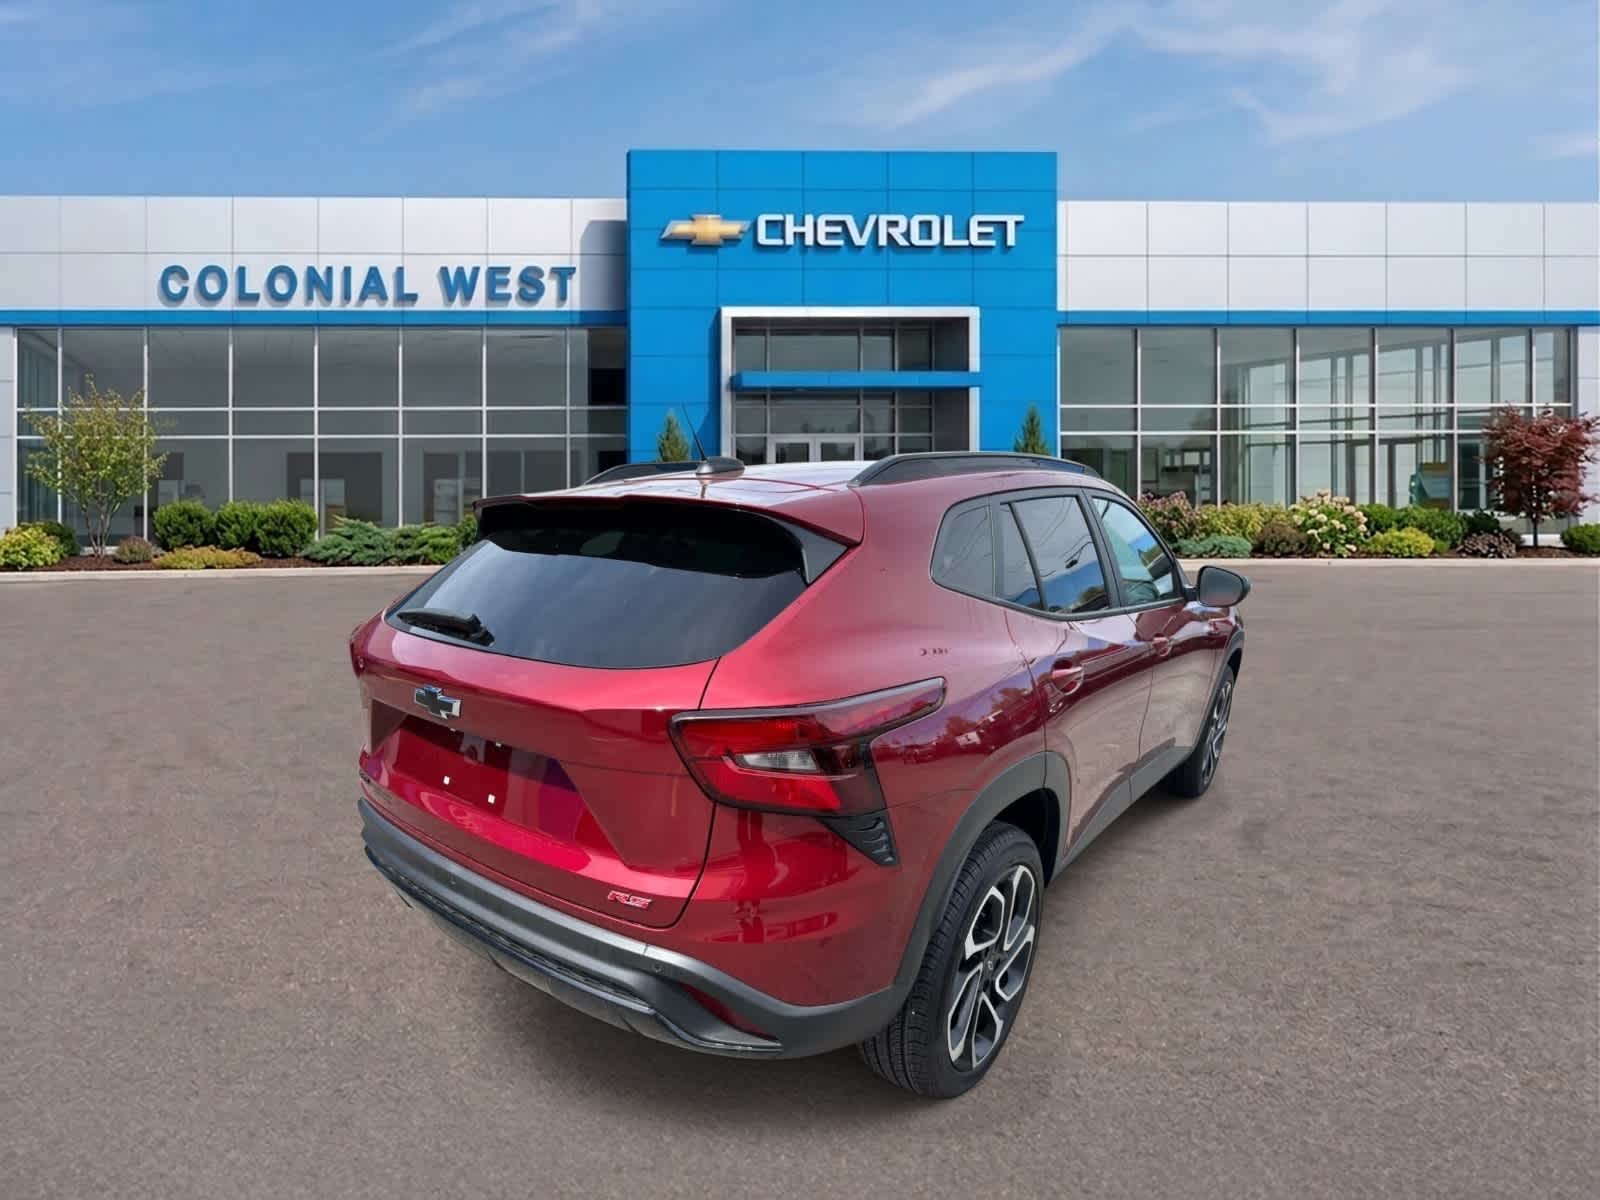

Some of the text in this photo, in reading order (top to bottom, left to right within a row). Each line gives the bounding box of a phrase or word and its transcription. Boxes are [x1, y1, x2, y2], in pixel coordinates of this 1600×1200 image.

[756, 214, 1024, 247] CHEVROLET
[160, 264, 577, 304] COLONIAL WEST
[607, 890, 652, 909] RS
